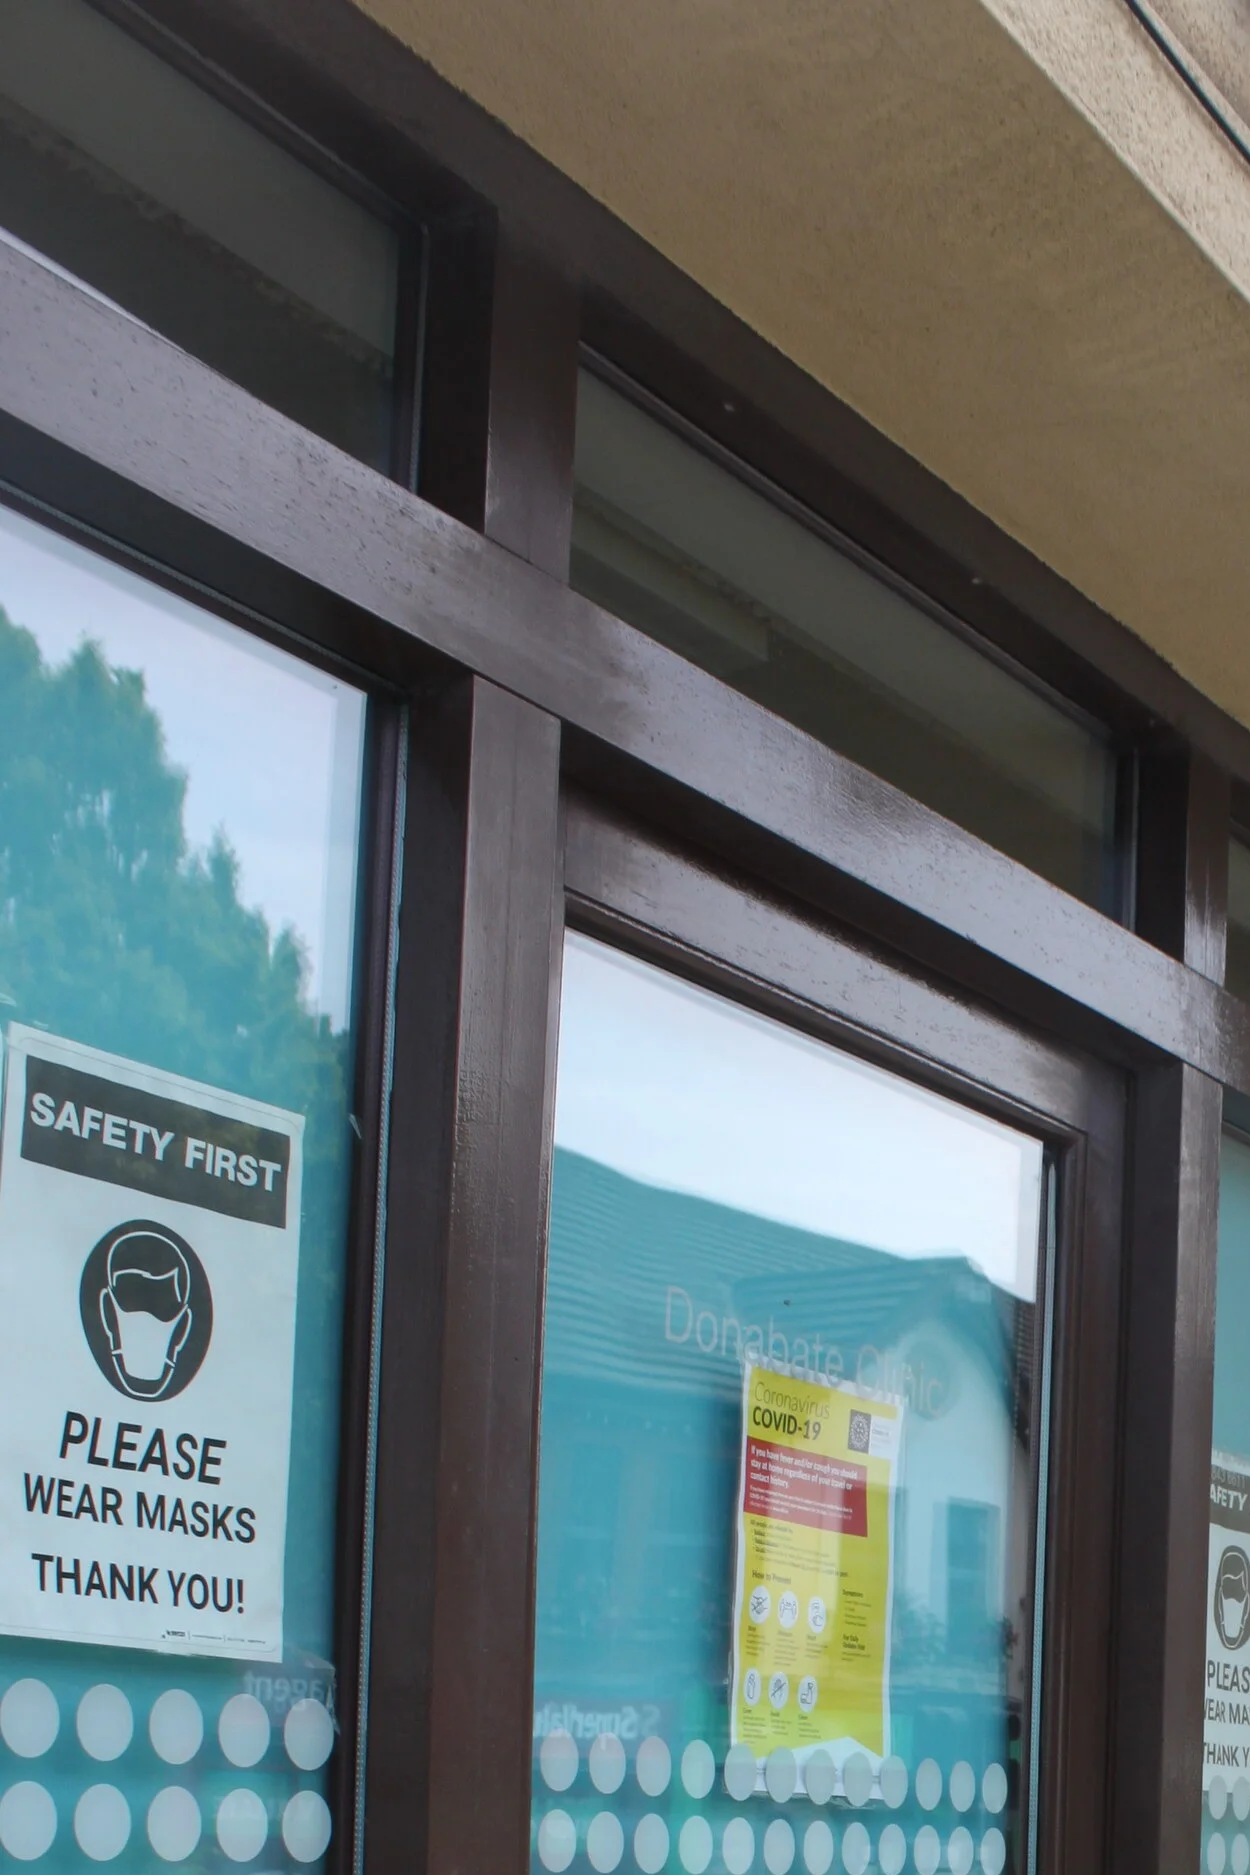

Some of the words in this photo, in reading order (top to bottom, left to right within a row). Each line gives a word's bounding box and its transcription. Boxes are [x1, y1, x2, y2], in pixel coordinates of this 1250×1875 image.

[30, 1092, 174, 1161] SAFETY
[185, 1136, 282, 1193] FIRST
[664, 1285, 844, 1388] Donabate
[753, 1406, 821, 1440] COVID-19
[754, 1381, 830, 1419] Coronavirus
[58, 1411, 227, 1485] PLEASE
[23, 1473, 122, 1526] WEAR
[135, 1490, 256, 1544] MASKS
[1210, 1483, 1248, 1512] AFETY
[31, 1552, 160, 1605] THANK
[166, 1568, 245, 1614] YOU!
